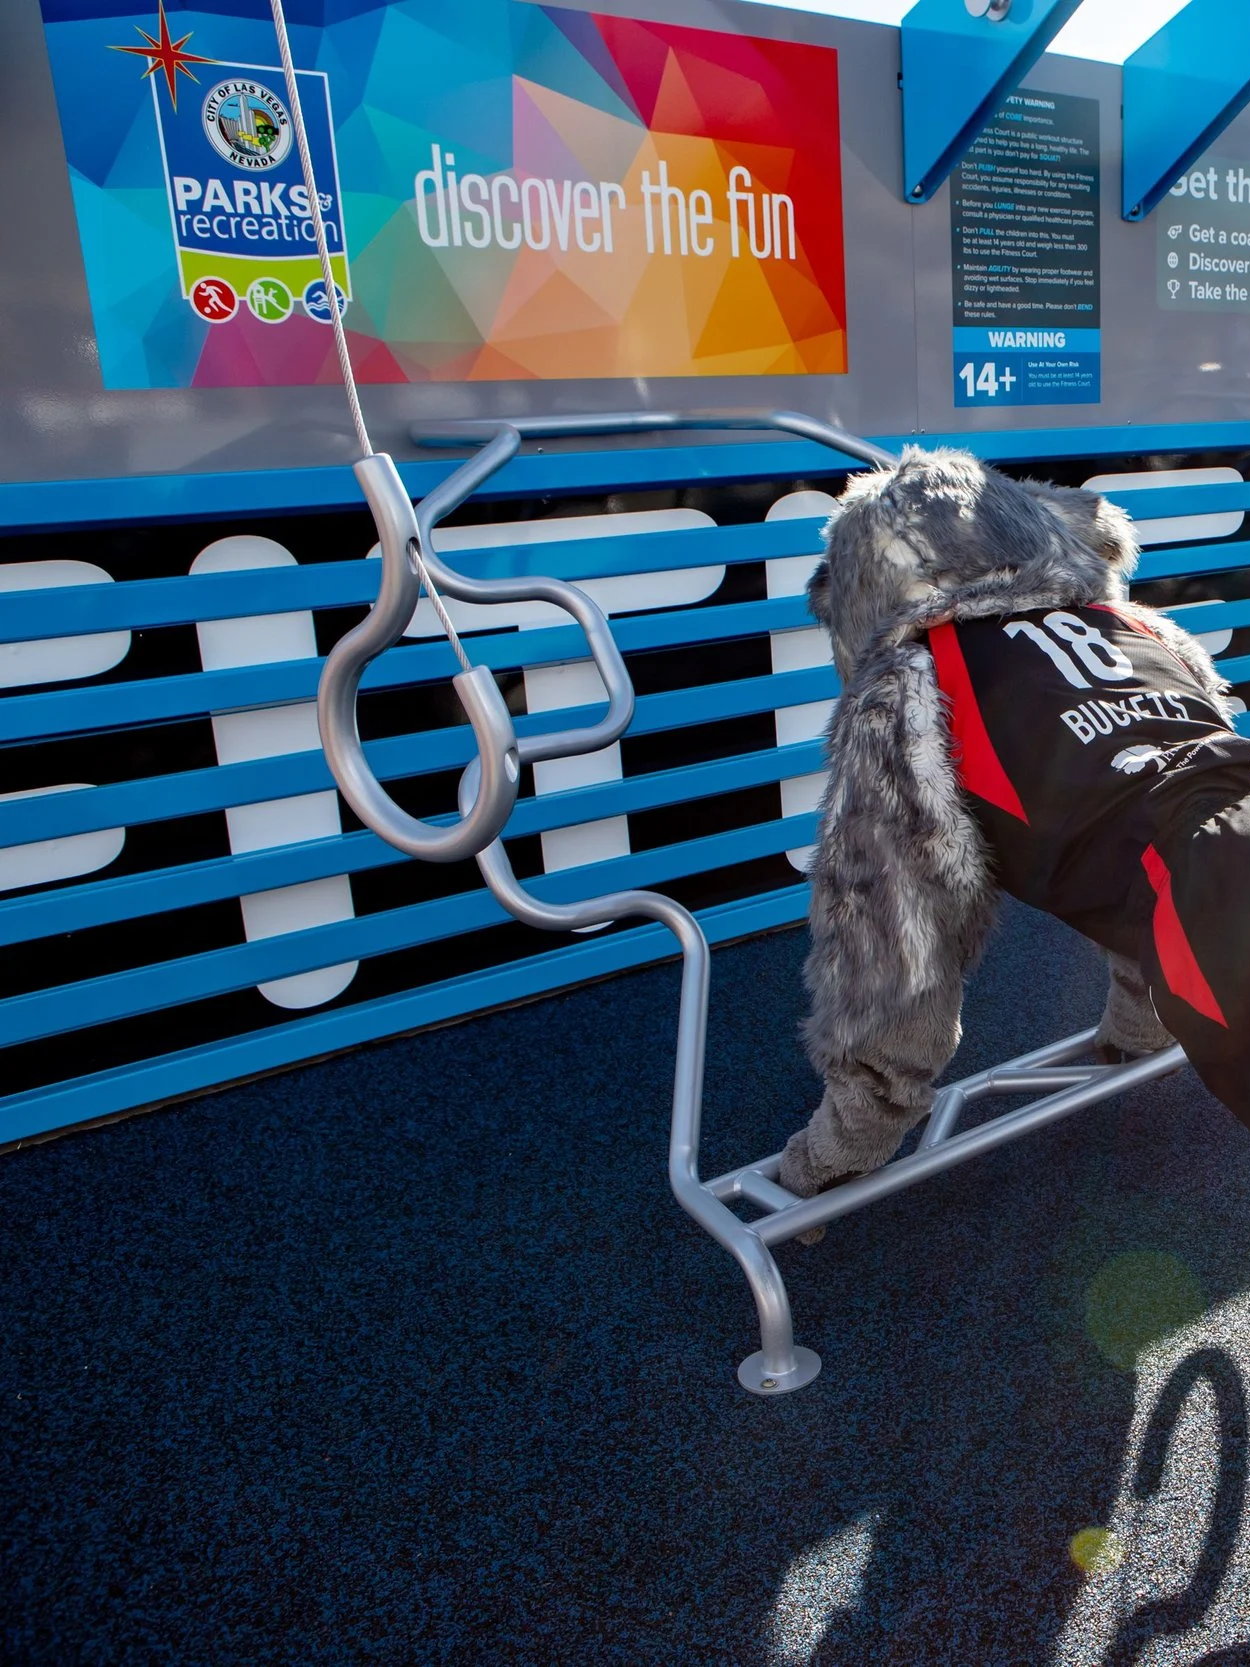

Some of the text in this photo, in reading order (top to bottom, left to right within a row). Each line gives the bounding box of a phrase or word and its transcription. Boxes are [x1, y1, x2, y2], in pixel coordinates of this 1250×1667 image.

[206, 84, 289, 126] CITY OF LAS VEGAS
[229, 152, 277, 168] NEVADA
[413, 143, 797, 260] discover the fun
[180, 212, 339, 242] recreation
[1189, 224, 1215, 244] Get
[1218, 230, 1227, 245] a
[1189, 252, 1250, 274] Discover
[1188, 280, 1222, 300] Take
[1225, 282, 1248, 301] the
[988, 331, 1066, 348] WARNING
[959, 362, 1016, 397] 14+
[1002, 611, 1133, 689] 18
[1175, 757, 1190, 769] The
